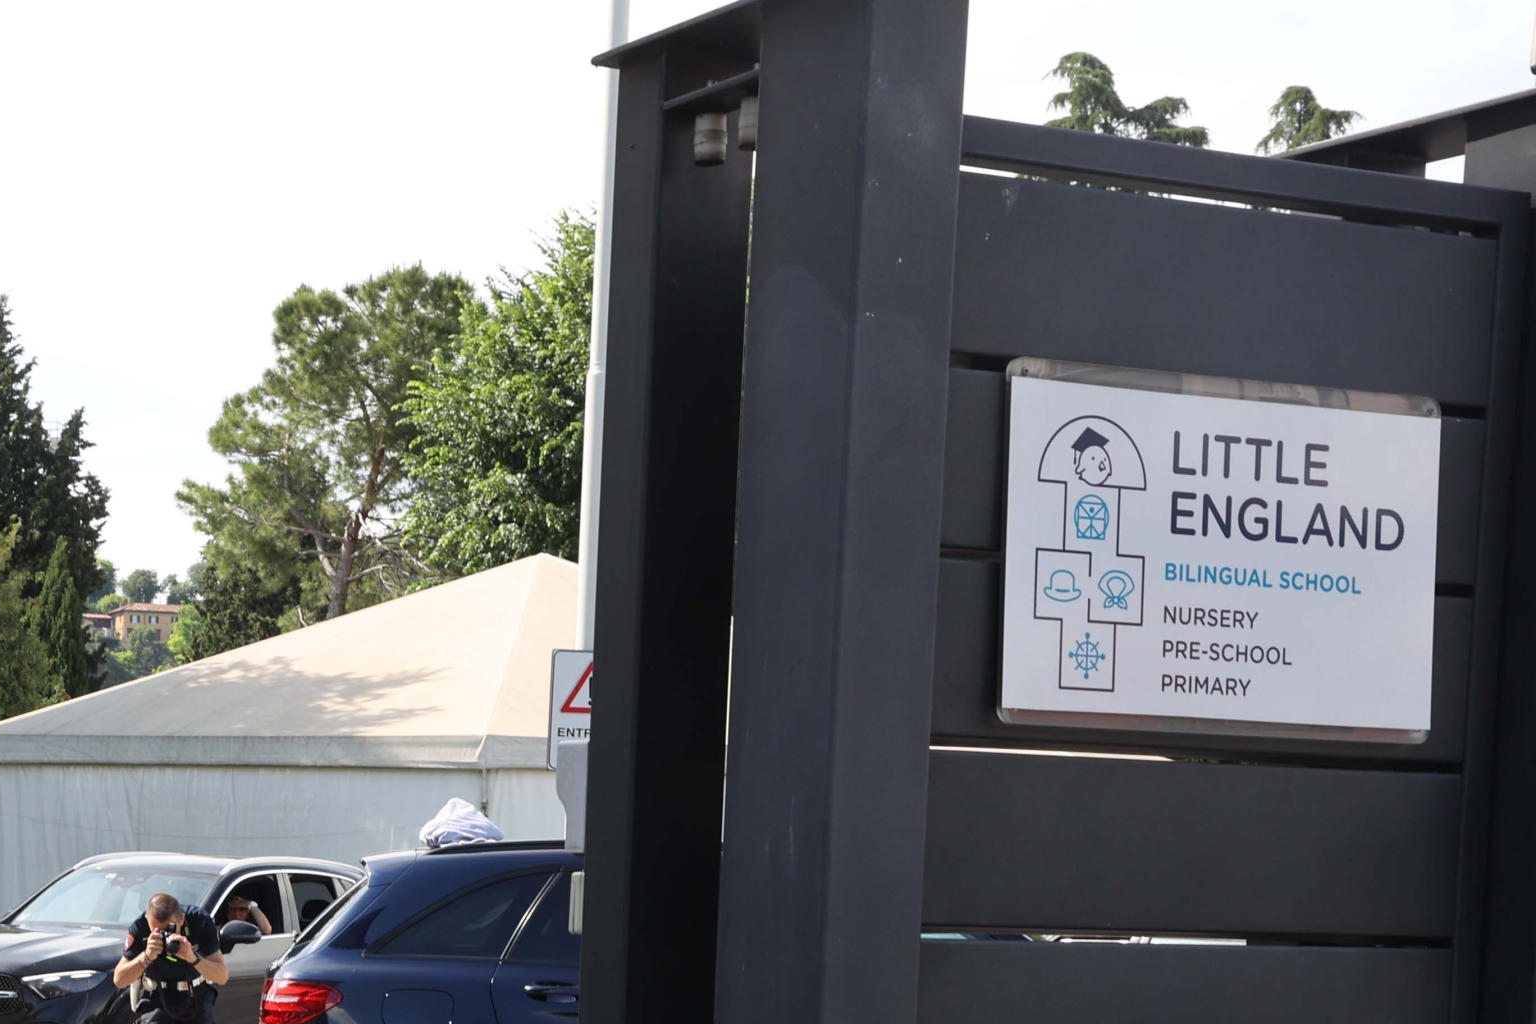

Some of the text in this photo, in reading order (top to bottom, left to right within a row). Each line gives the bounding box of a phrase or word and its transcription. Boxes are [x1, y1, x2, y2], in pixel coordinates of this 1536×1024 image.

[1173, 430, 1330, 487] LITTLE
[1170, 491, 1405, 551] ENGLAND
[1164, 562, 1362, 595] BILINGUAL SCHOOL
[1163, 605, 1259, 630] NURSERY
[1162, 640, 1293, 666] PRE-SCHOOL
[1161, 674, 1251, 697] PRIMARY
[557, 727, 591, 737] ENTR
